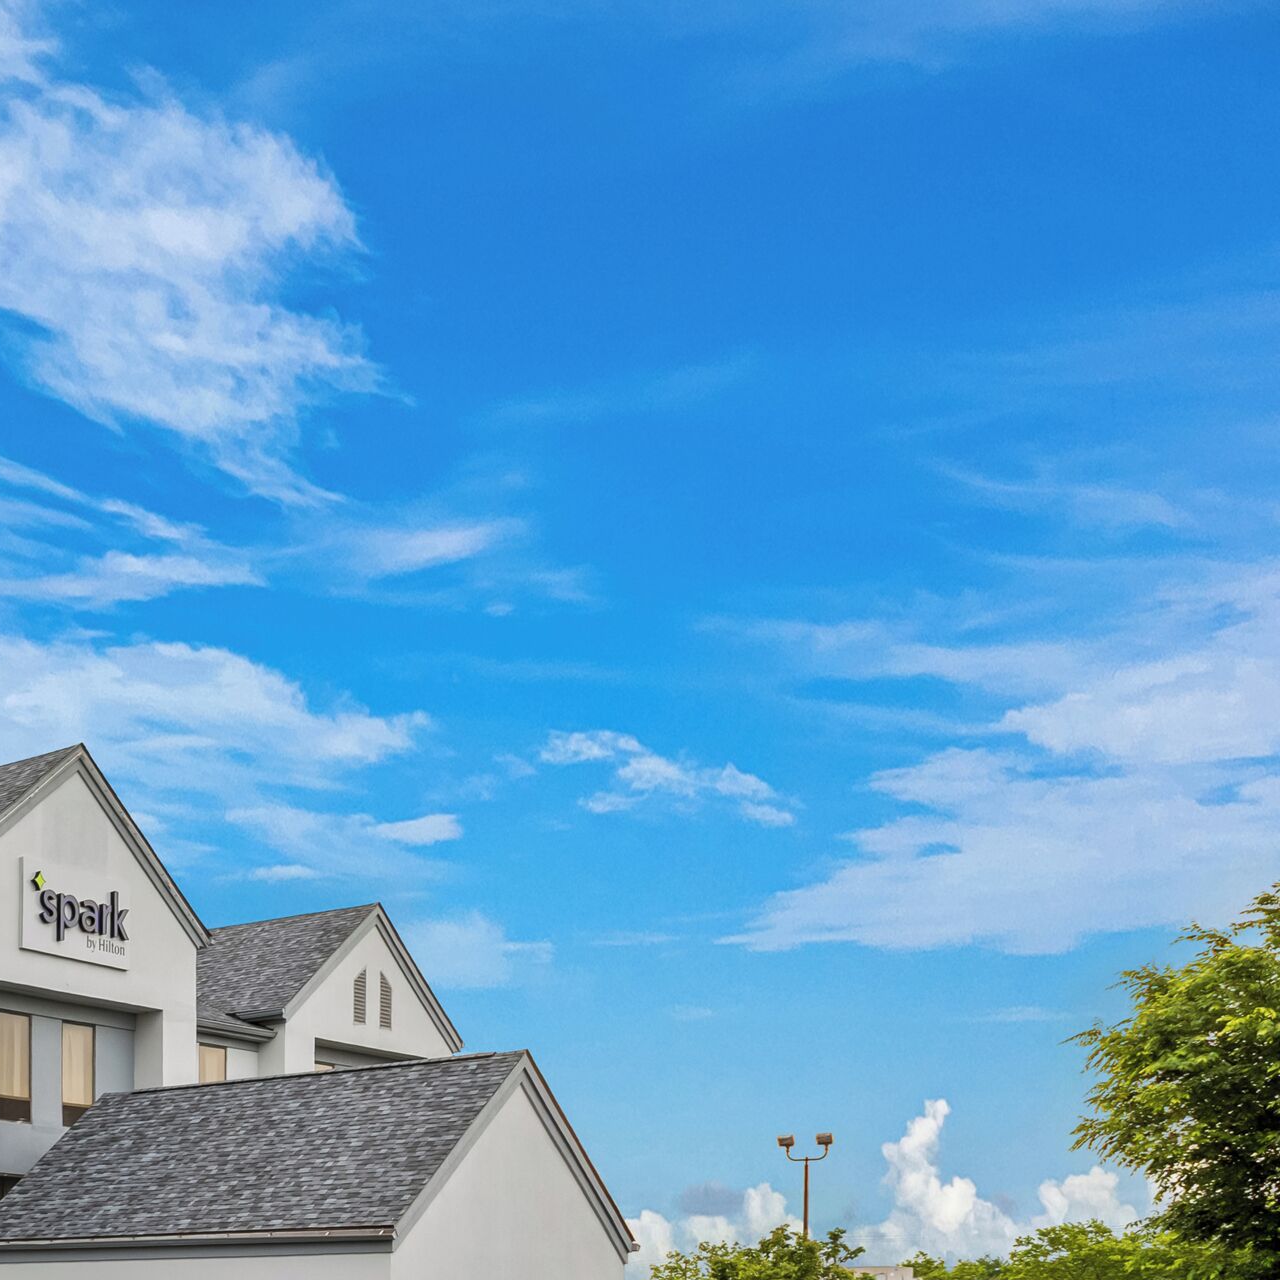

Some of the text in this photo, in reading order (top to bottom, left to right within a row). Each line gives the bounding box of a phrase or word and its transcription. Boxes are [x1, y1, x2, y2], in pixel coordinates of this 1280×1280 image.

[39, 889, 129, 942] spark
[86, 936, 125, 956] by Hilton
